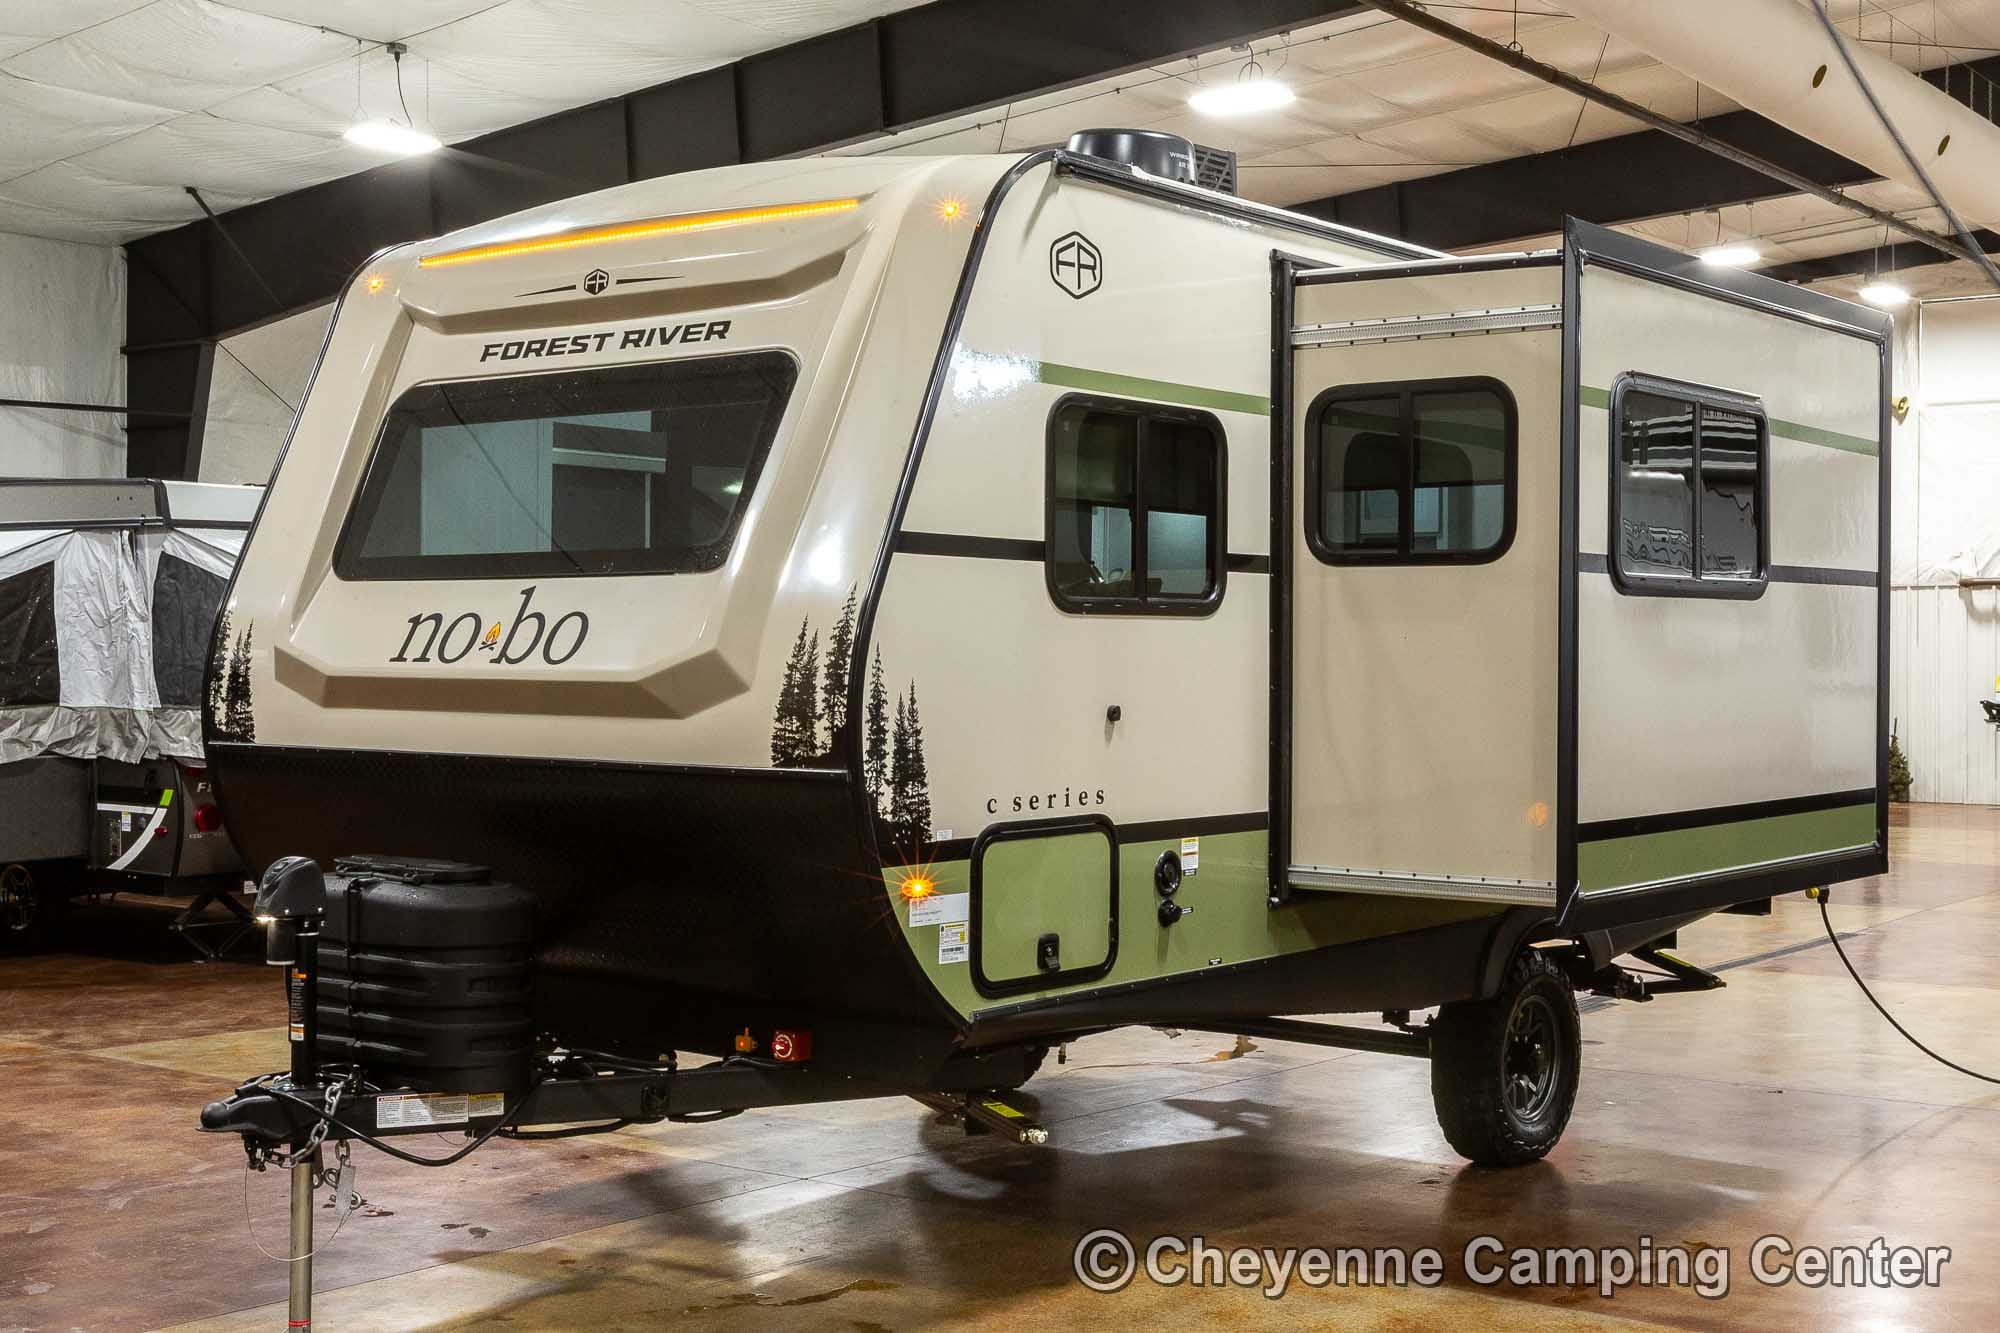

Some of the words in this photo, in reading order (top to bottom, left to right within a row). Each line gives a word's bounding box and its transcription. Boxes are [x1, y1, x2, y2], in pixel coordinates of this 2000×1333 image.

[1055, 238, 1098, 291] FR
[479, 332, 615, 363] FOREST
[619, 320, 732, 350] RIVER
[1011, 786, 1105, 813] series
